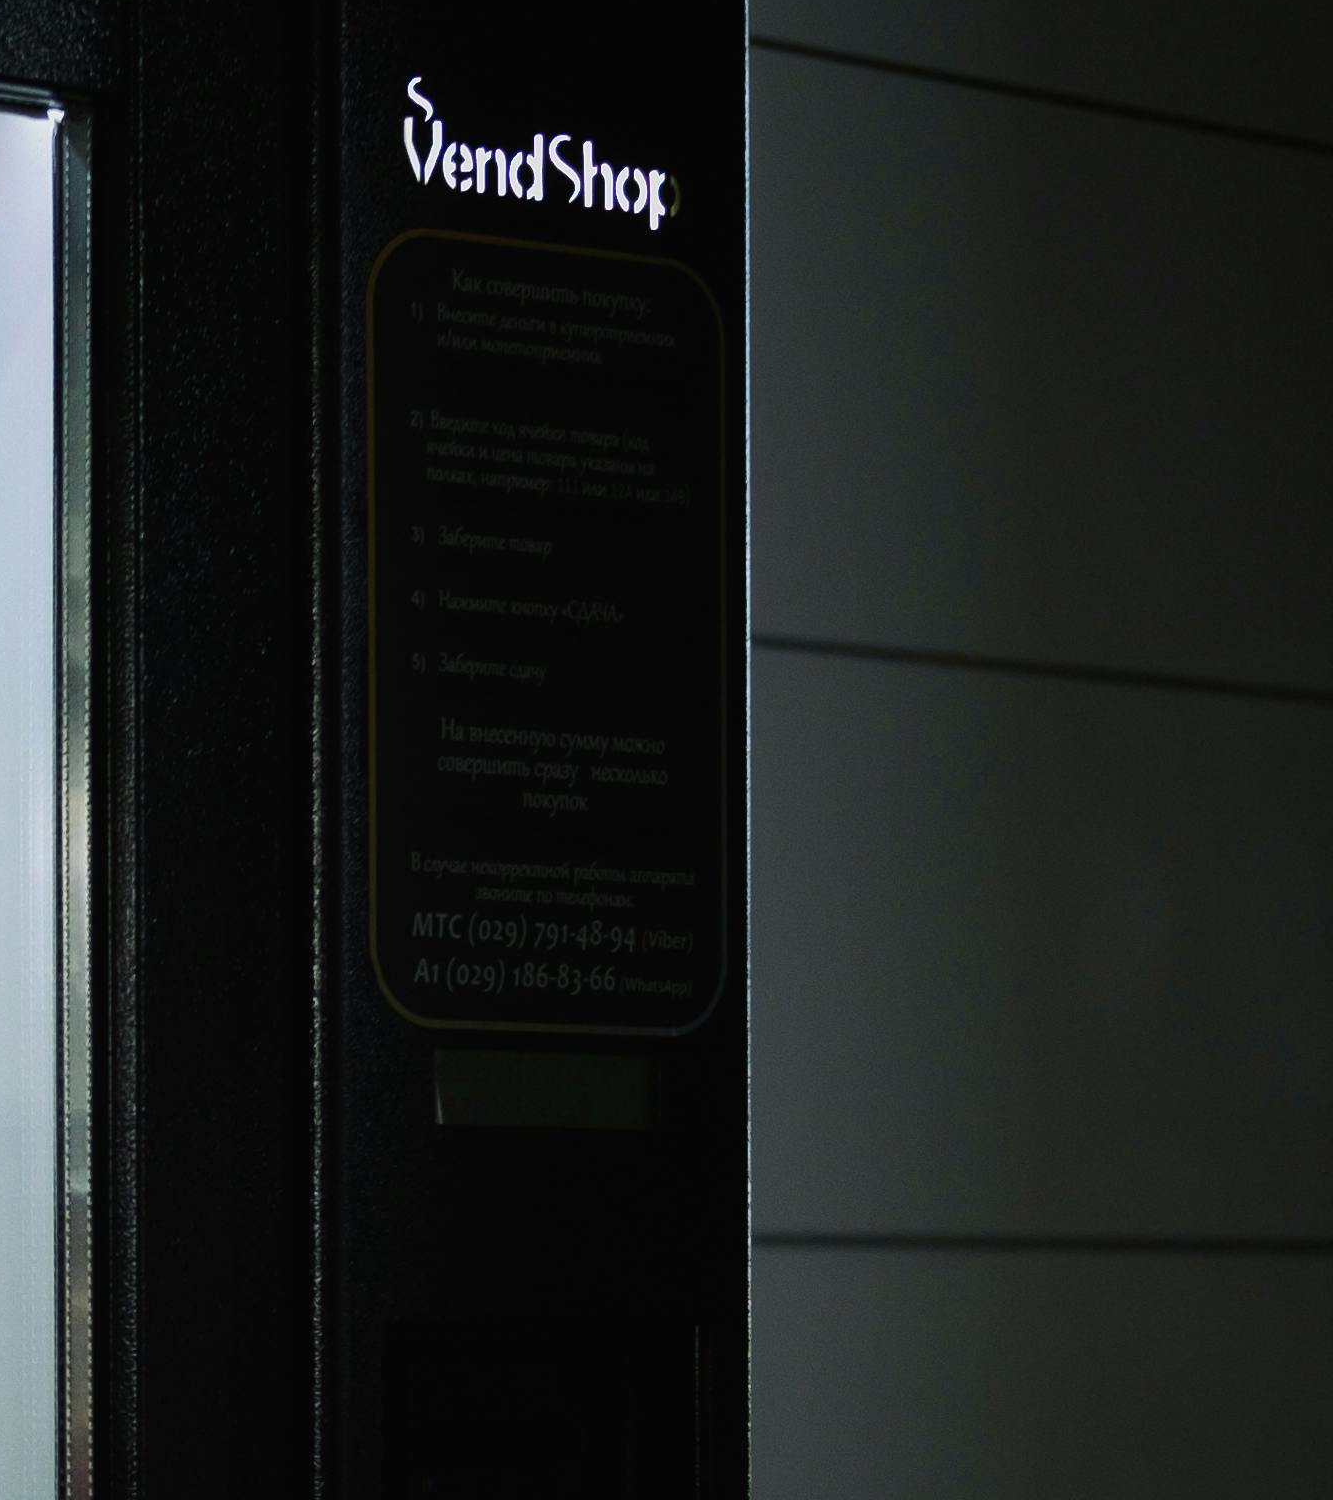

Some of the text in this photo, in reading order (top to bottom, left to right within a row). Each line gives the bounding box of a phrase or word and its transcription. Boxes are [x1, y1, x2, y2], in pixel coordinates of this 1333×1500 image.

[403, 115, 682, 231] VendShop
[409, 301, 424, 322] 1)
[451, 268, 652, 320] Как совершить покупку:
[409, 410, 424, 430] 2)
[430, 410, 489, 434] Введите
[492, 423, 516, 439] код
[410, 525, 552, 563] 3) Заберите товар
[410, 589, 425, 610] 4)
[438, 588, 508, 614] Нажмите
[510, 599, 558, 624] кнопку
[410, 652, 547, 687] 5) Заберите сдачу
[440, 716, 665, 758] На внесенную сумму можно
[437, 754, 669, 788] совершить сразу несколько
[522, 789, 589, 817] покупок
[409, 851, 421, 873] В
[423, 858, 467, 880] случае
[574, 861, 626, 883] работы
[630, 870, 695, 890] аппарата
[537, 891, 552, 904] по
[412, 911, 694, 954] МТС (029) 791-48-94 (Viber)
[446, 956, 506, 993] (029)
[514, 962, 616, 995] 186-83-66
[620, 976, 693, 997] (WhatsApp)
